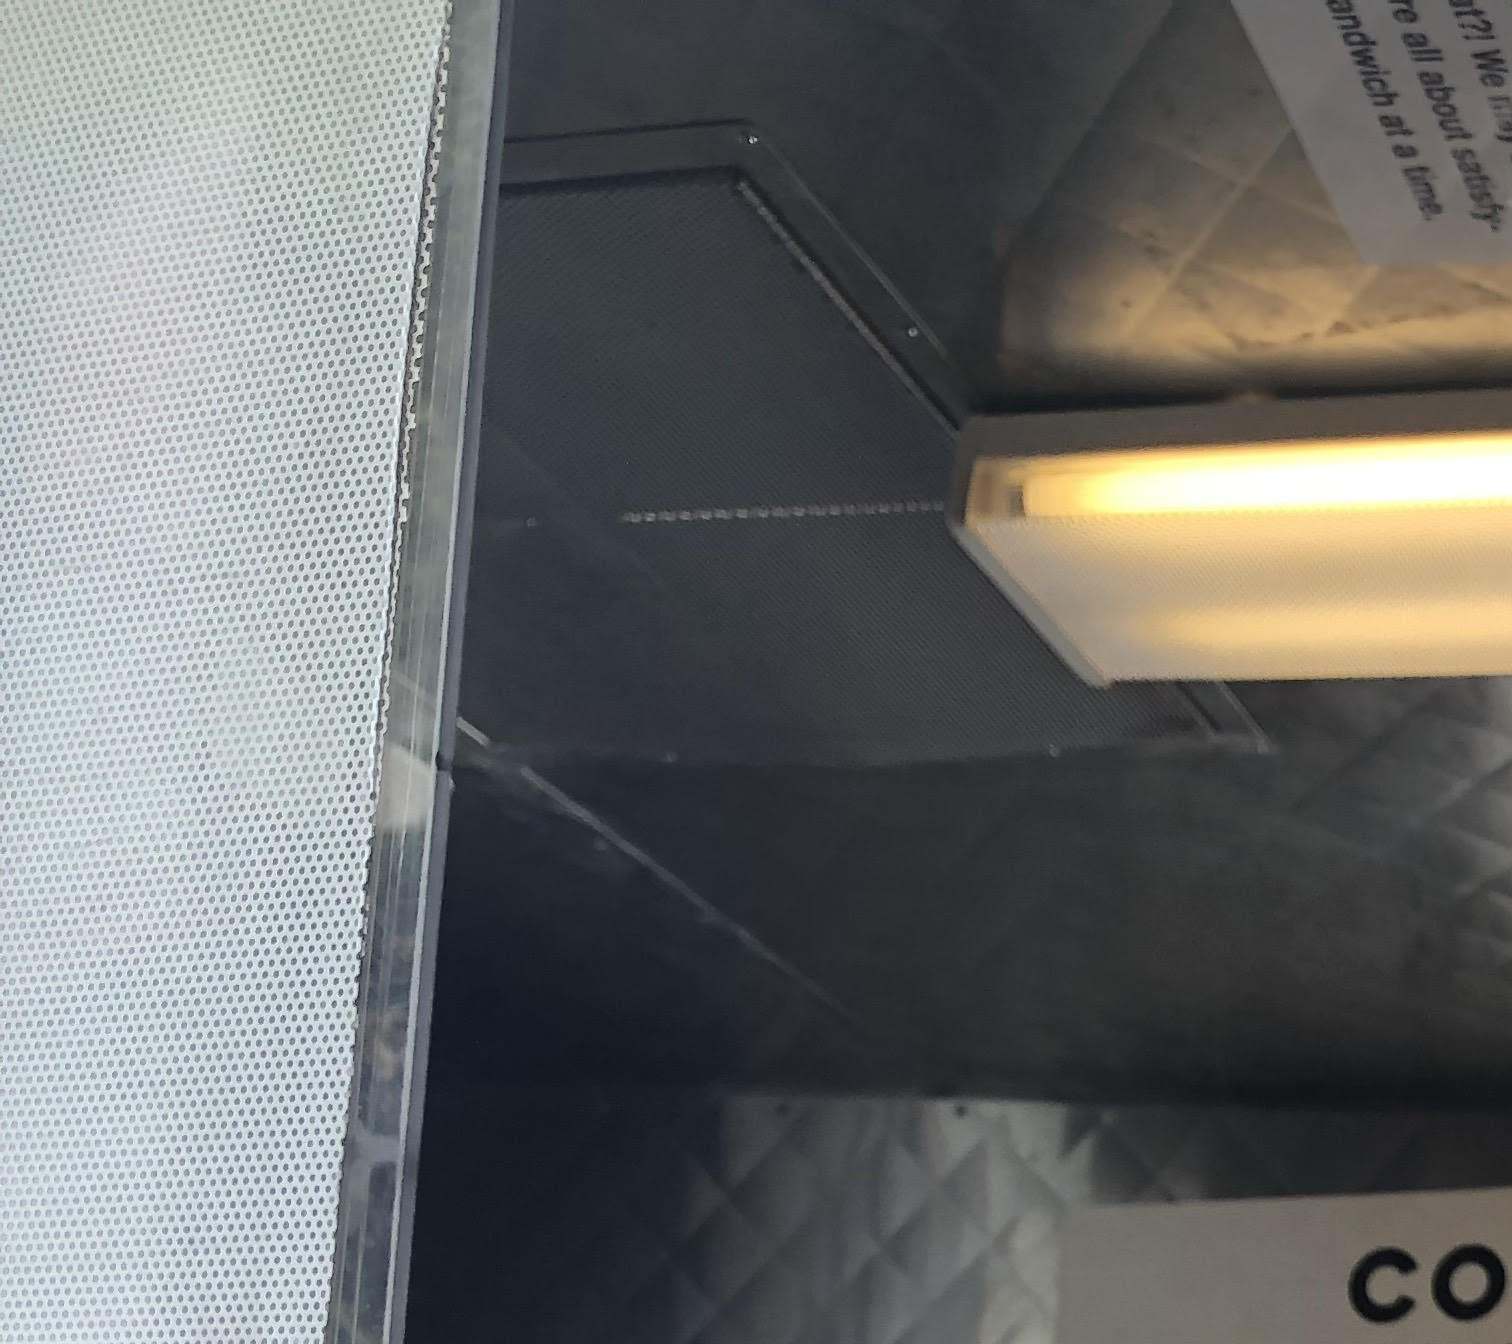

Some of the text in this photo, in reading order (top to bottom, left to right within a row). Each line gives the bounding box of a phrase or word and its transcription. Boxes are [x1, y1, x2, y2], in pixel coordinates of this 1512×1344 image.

[1401, 33, 1444, 62] all
[1472, 49, 1510, 88] We
[1418, 71, 1474, 141] about
[1378, 114, 1415, 136] at
[1392, 144, 1420, 159] a
